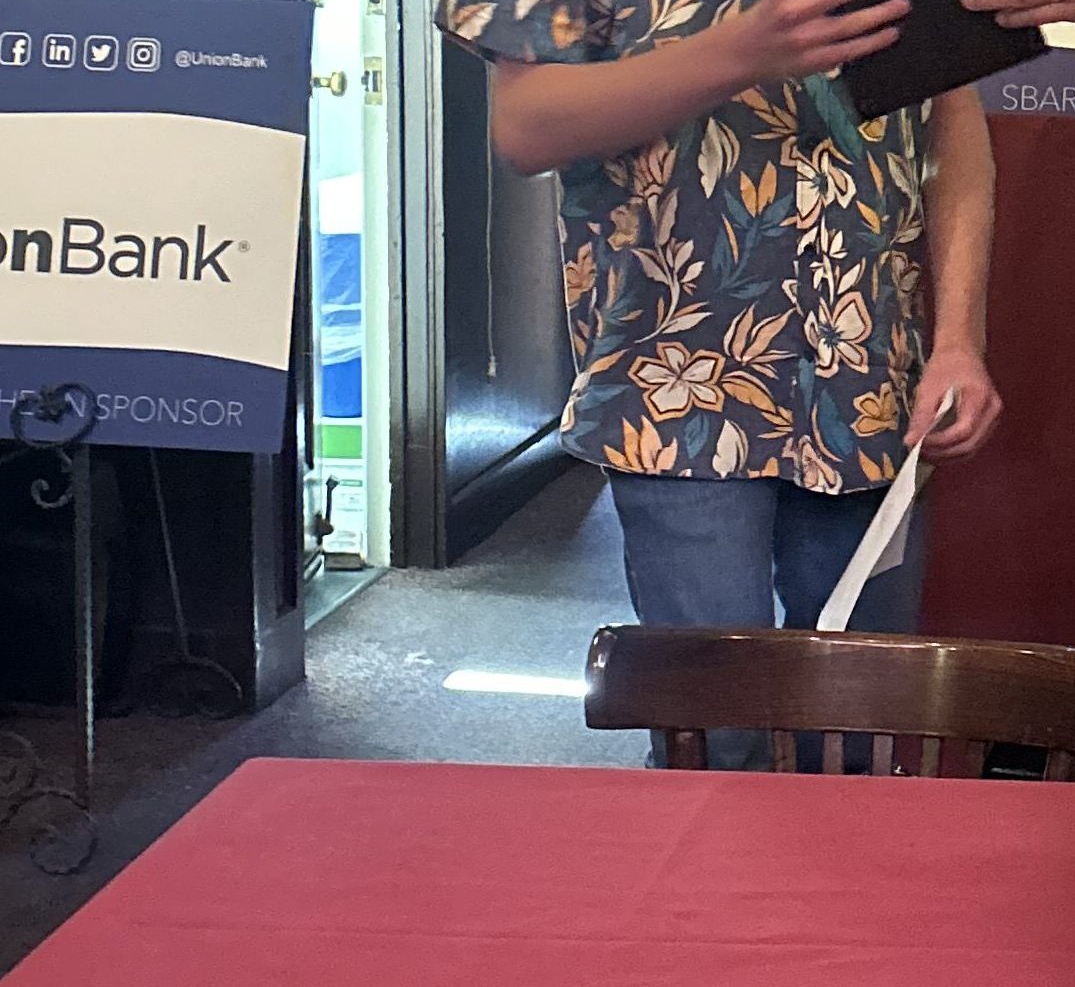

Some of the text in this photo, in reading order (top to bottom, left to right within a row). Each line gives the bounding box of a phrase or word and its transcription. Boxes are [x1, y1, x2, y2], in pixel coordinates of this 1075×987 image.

[175, 50, 269, 69] @UnionBank
[0, 216, 234, 283] nBank
[96, 393, 244, 427] SPONSOR
